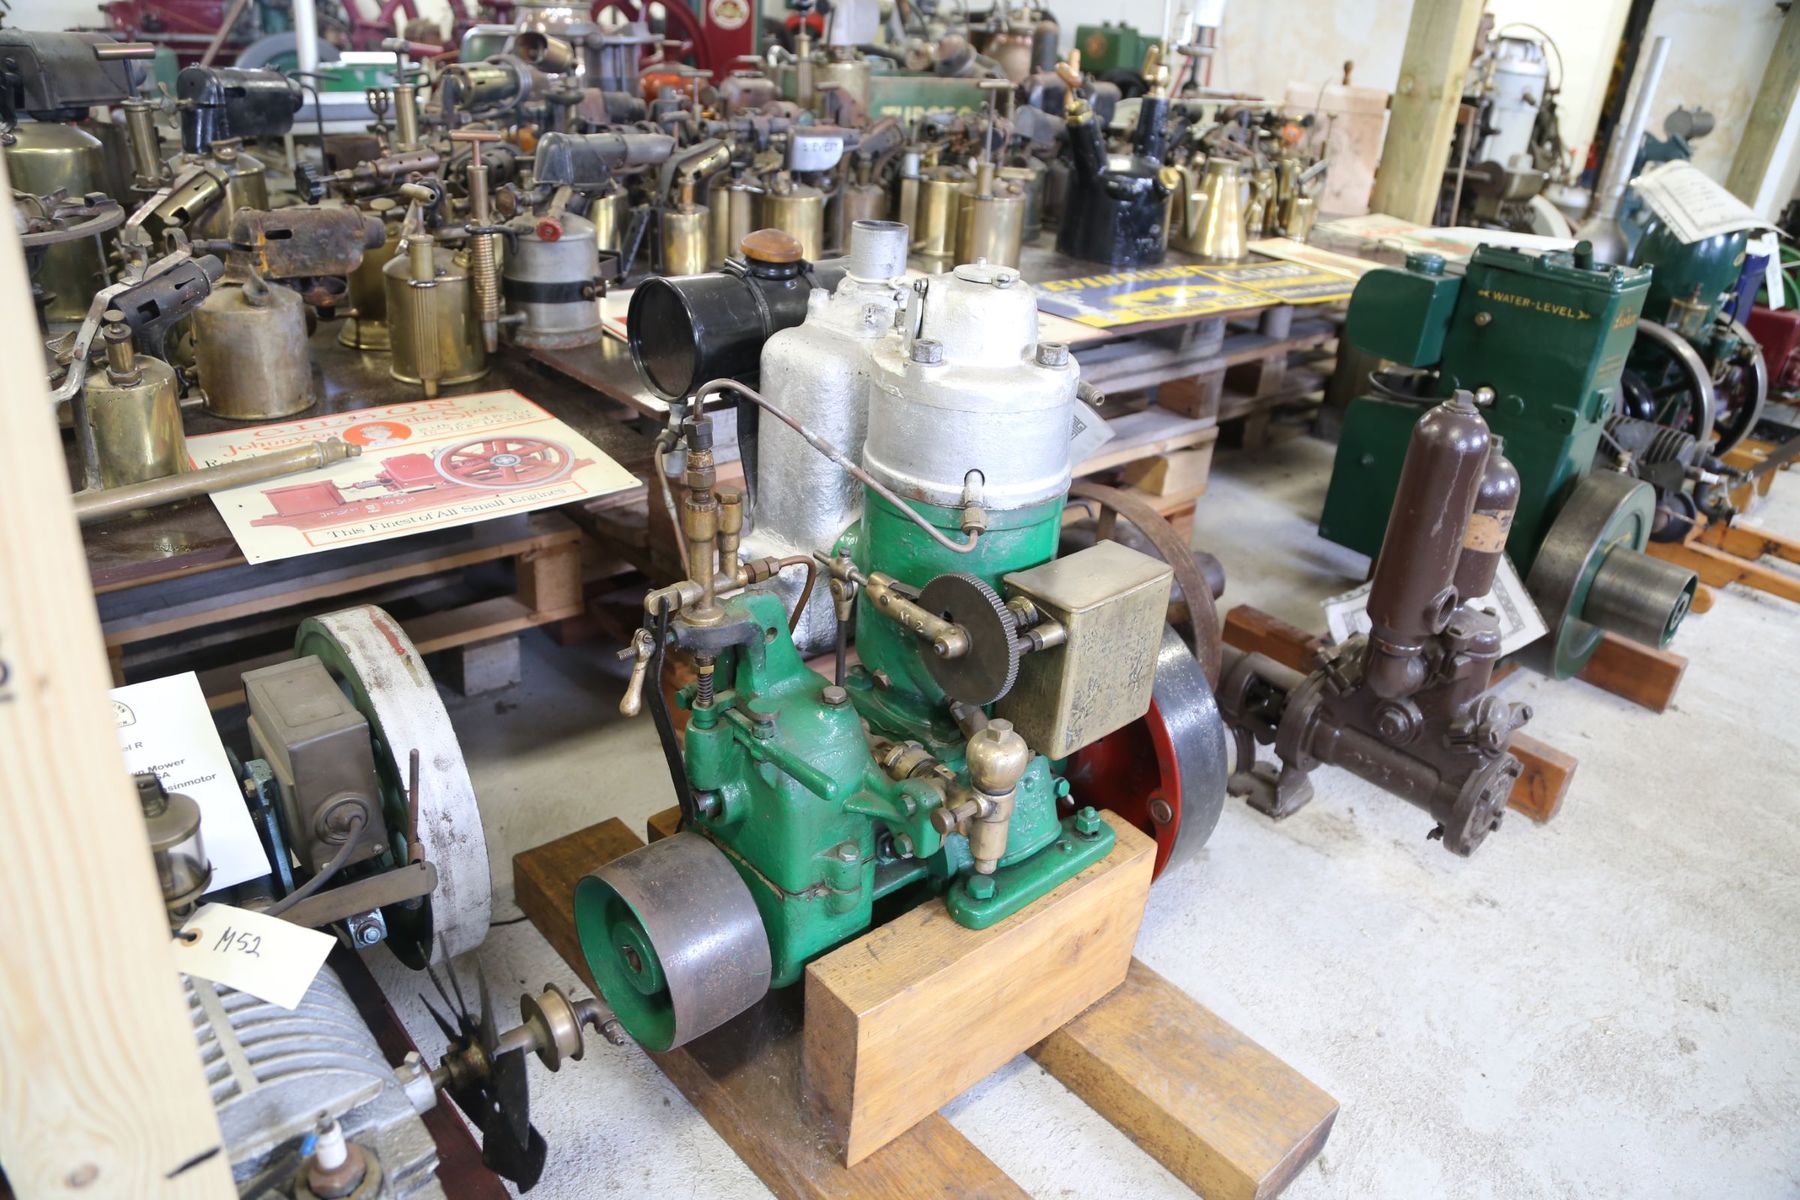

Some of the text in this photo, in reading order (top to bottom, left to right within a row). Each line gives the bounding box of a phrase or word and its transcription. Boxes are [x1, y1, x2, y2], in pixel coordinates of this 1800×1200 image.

[1493, 291, 1575, 319] WATER-LEVEL
[461, 498, 505, 514] Small
[134, 741, 144, 749] R
[147, 758, 187, 775] Mower
[213, 926, 262, 958] M52
